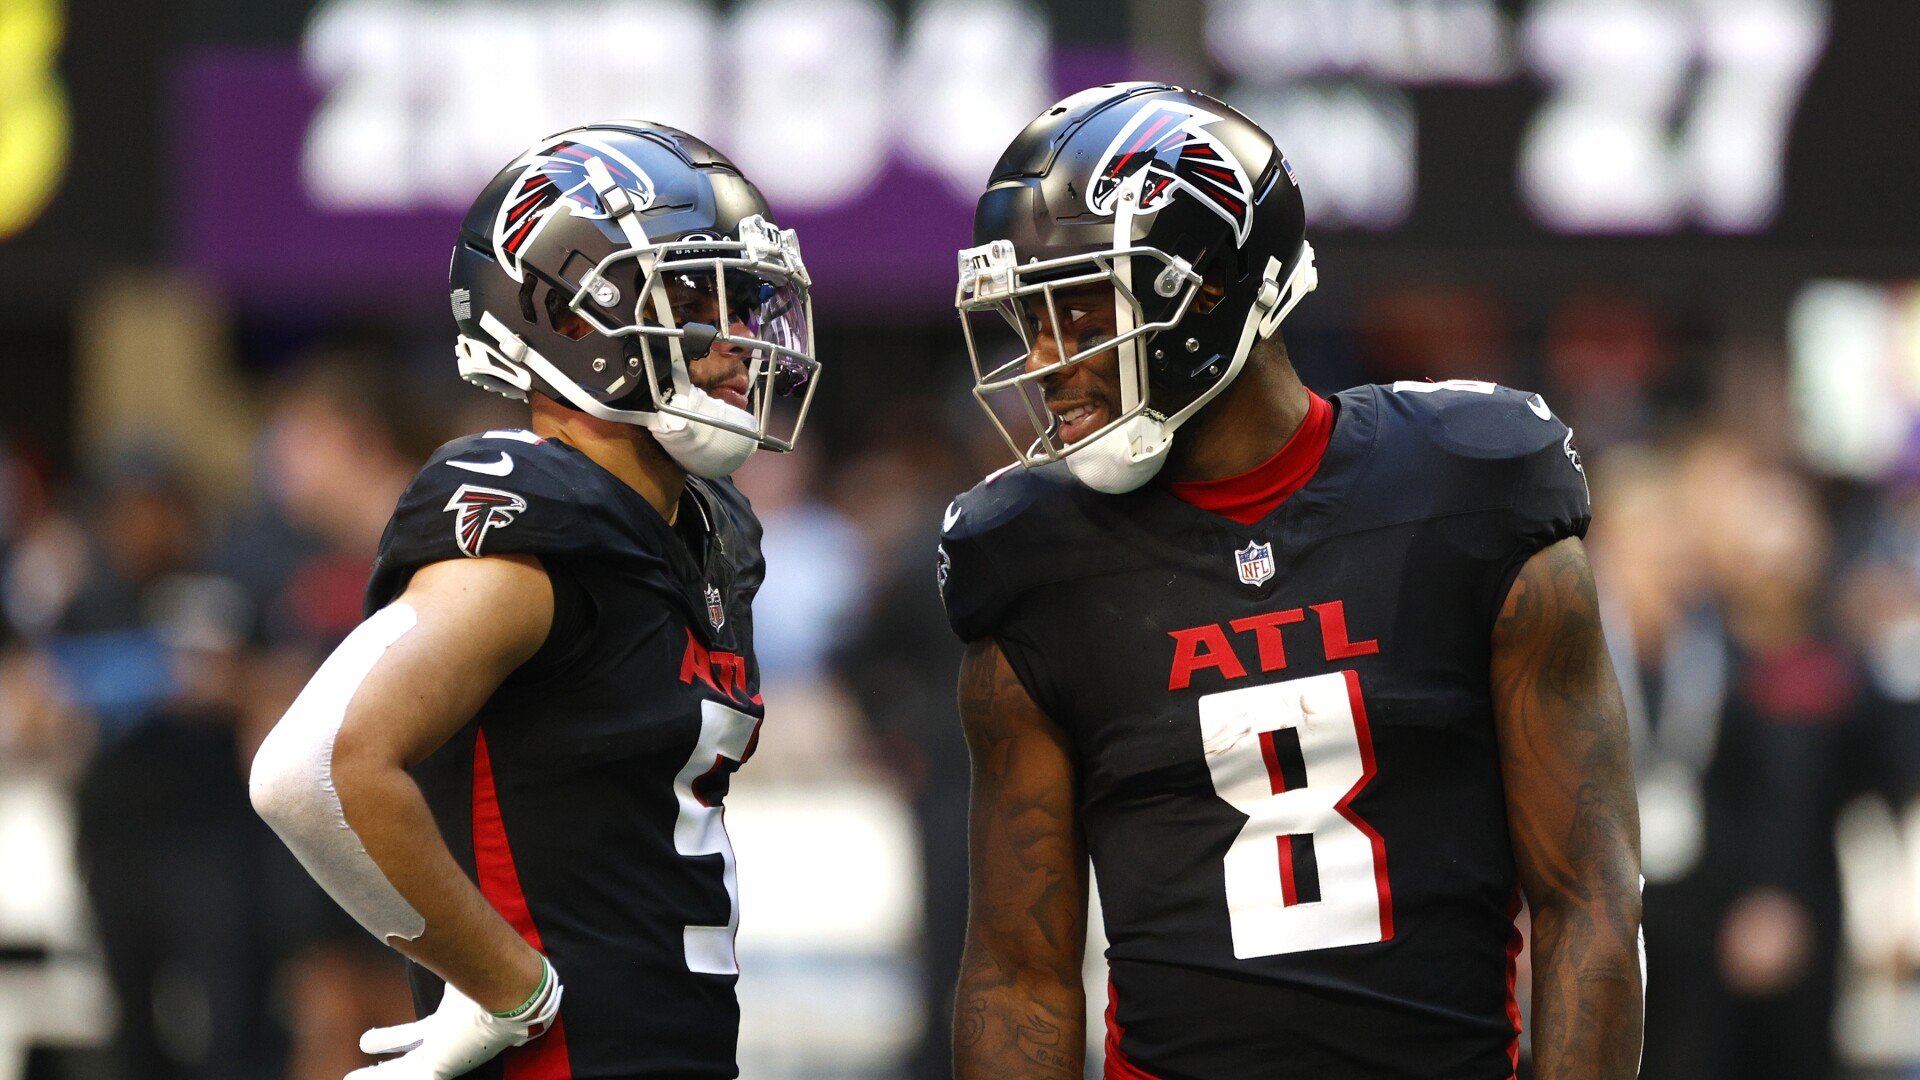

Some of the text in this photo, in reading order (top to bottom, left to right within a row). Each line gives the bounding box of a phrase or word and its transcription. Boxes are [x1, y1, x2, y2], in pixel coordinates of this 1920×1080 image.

[1243, 559, 1269, 579] NFL
[680, 626, 764, 706] ATL
[1168, 599, 1379, 691] ATL
[673, 698, 763, 976] 5
[1198, 669, 1394, 960] 8
